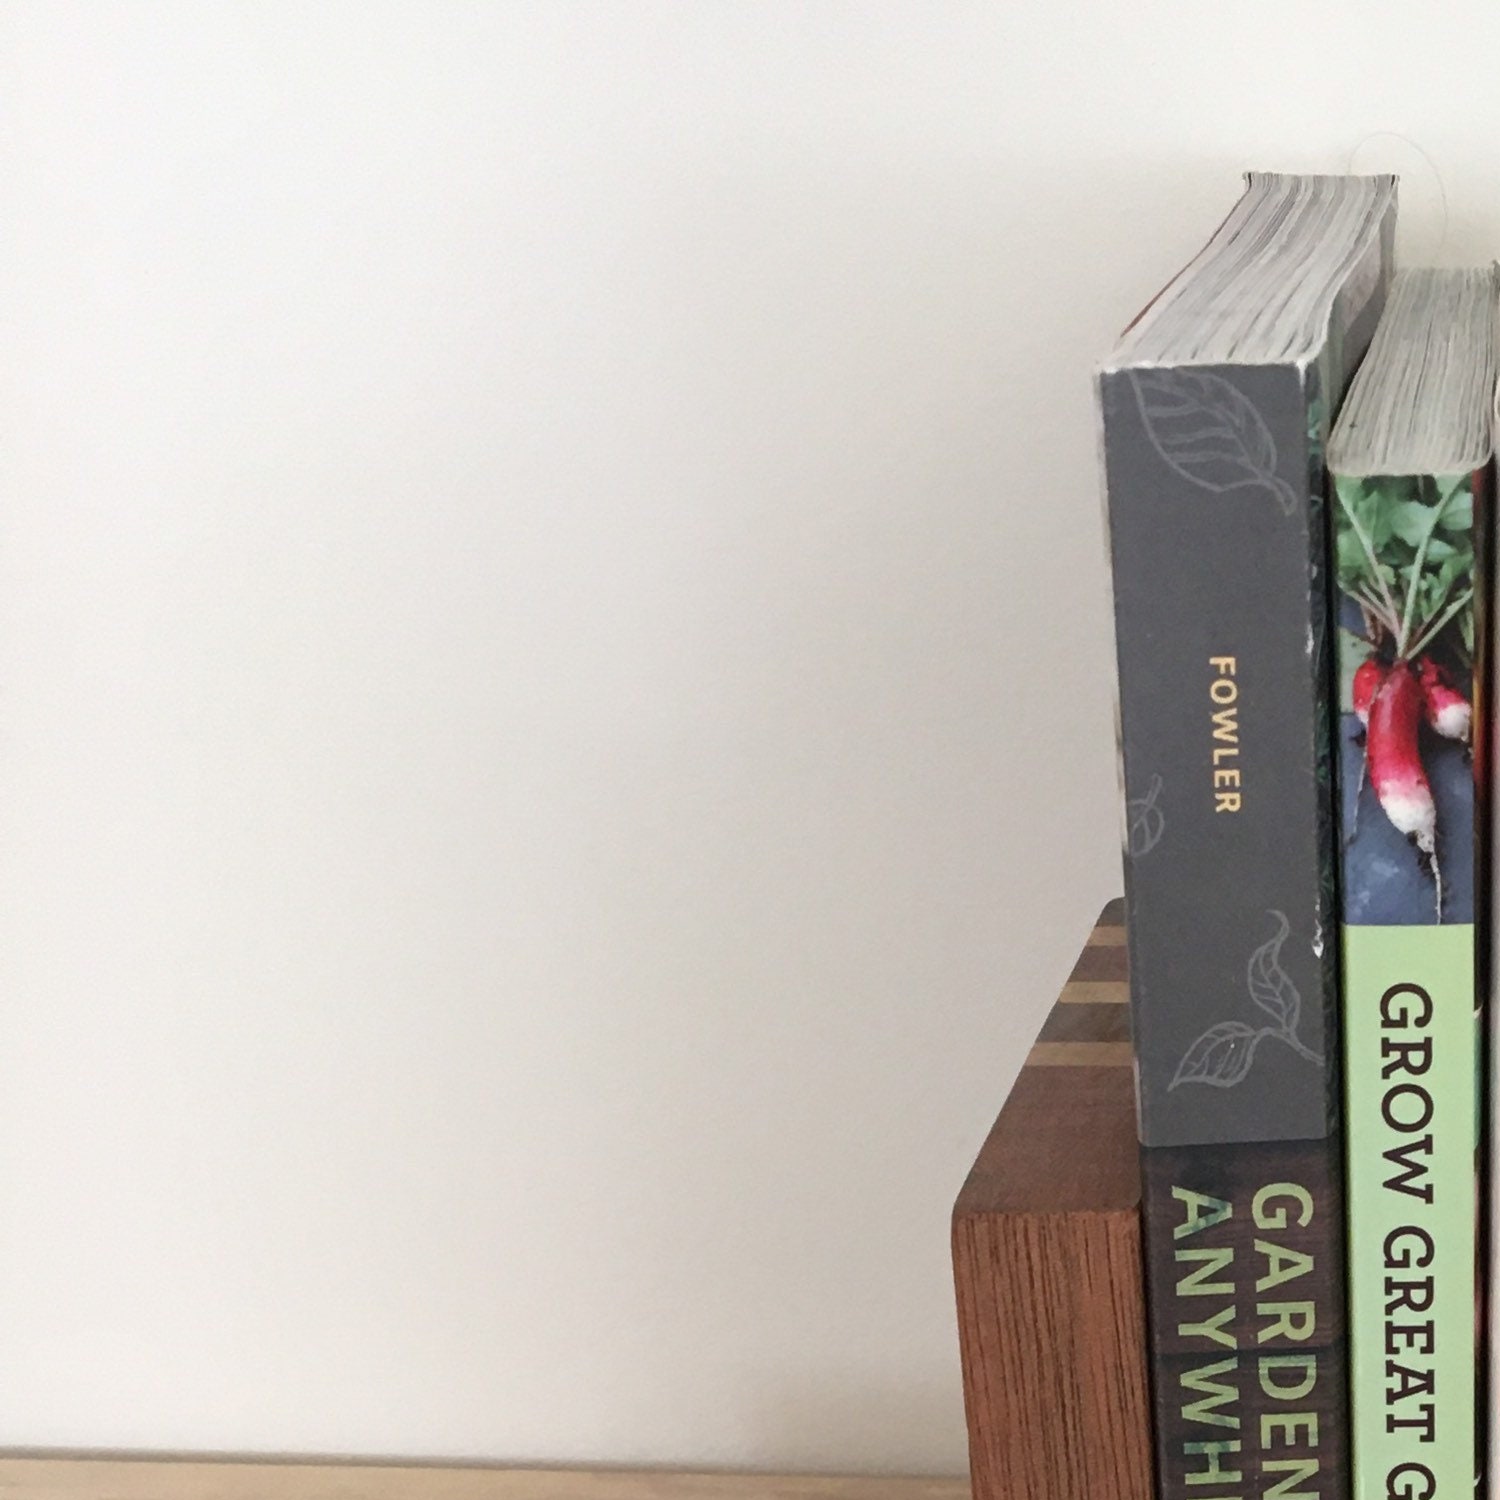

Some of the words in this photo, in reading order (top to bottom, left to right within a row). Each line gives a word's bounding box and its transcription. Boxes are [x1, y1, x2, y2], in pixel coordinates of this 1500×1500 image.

[1209, 656, 1241, 814] FOWLER
[1379, 982, 1434, 1204] GROW
[1382, 1226, 1436, 1443] GREAT
